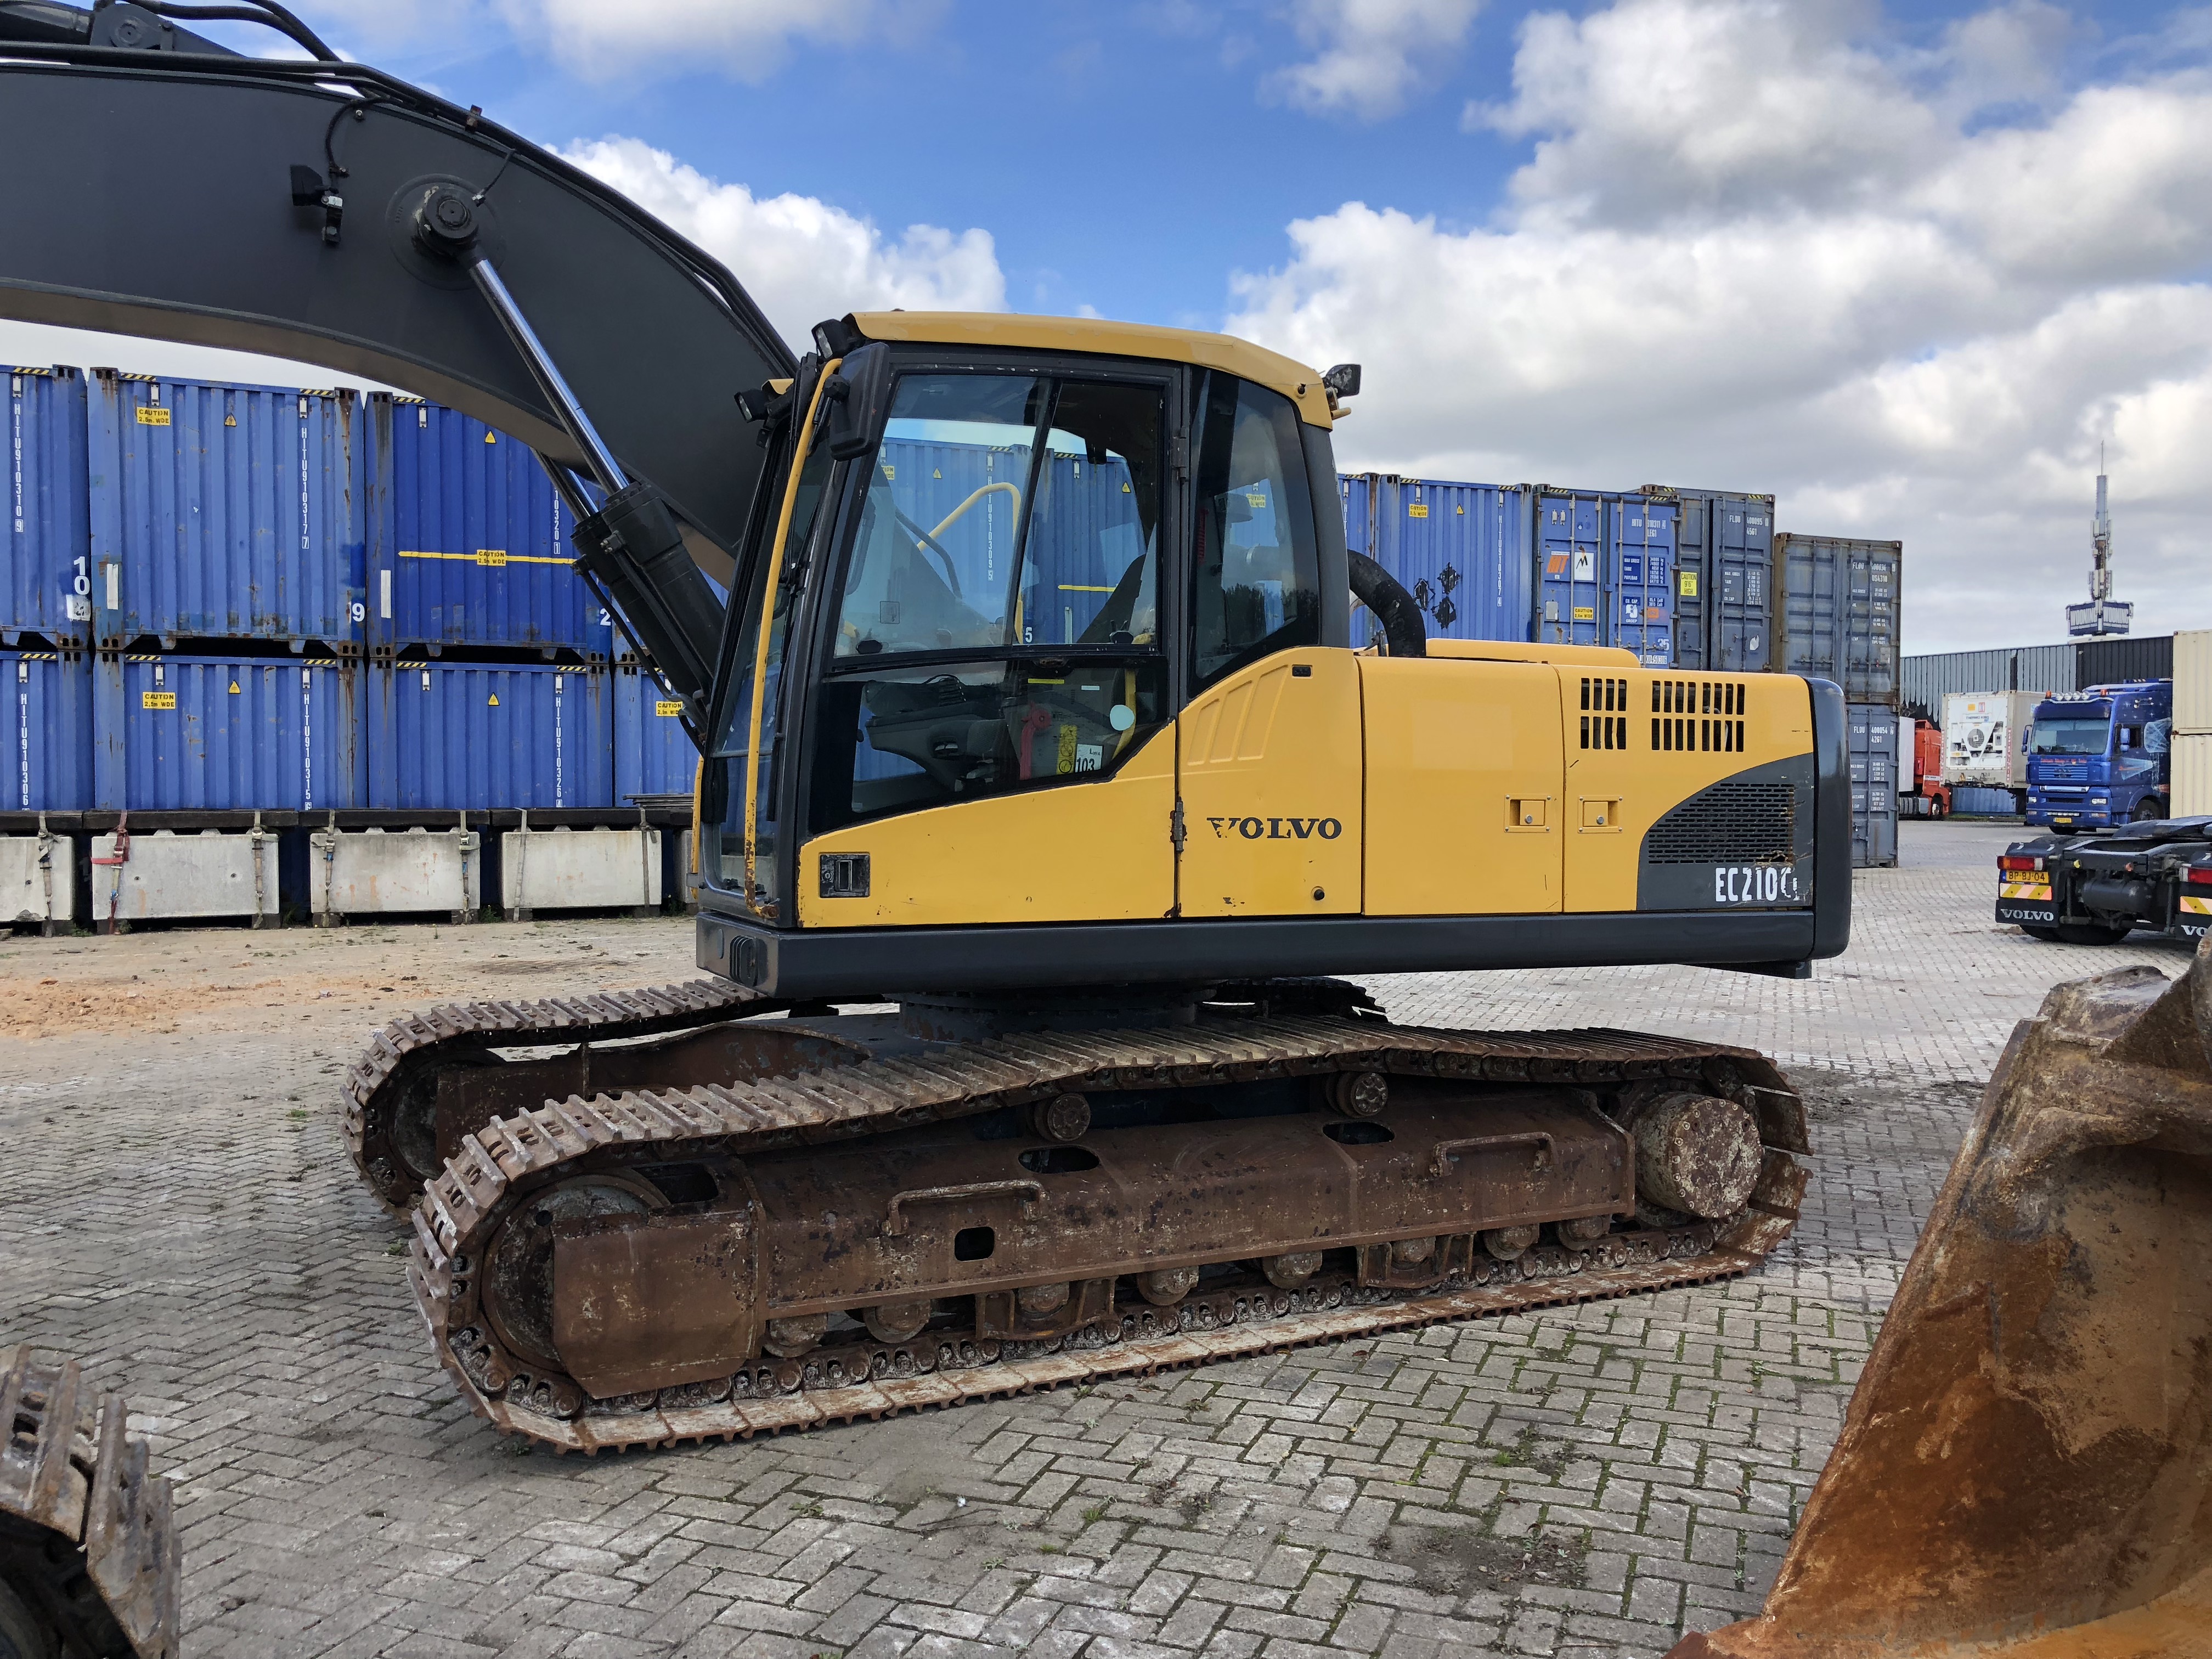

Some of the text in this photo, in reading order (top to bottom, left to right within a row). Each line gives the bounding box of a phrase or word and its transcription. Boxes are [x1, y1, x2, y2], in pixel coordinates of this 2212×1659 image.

[600, 608, 611, 626] 2
[1025, 627, 1032, 643] 5
[20, 693, 29, 805] HITU910306
[1076, 757, 1095, 772] 103
[1206, 817, 1342, 839] VOLVO
[2000, 909, 2054, 921] VOLVO
